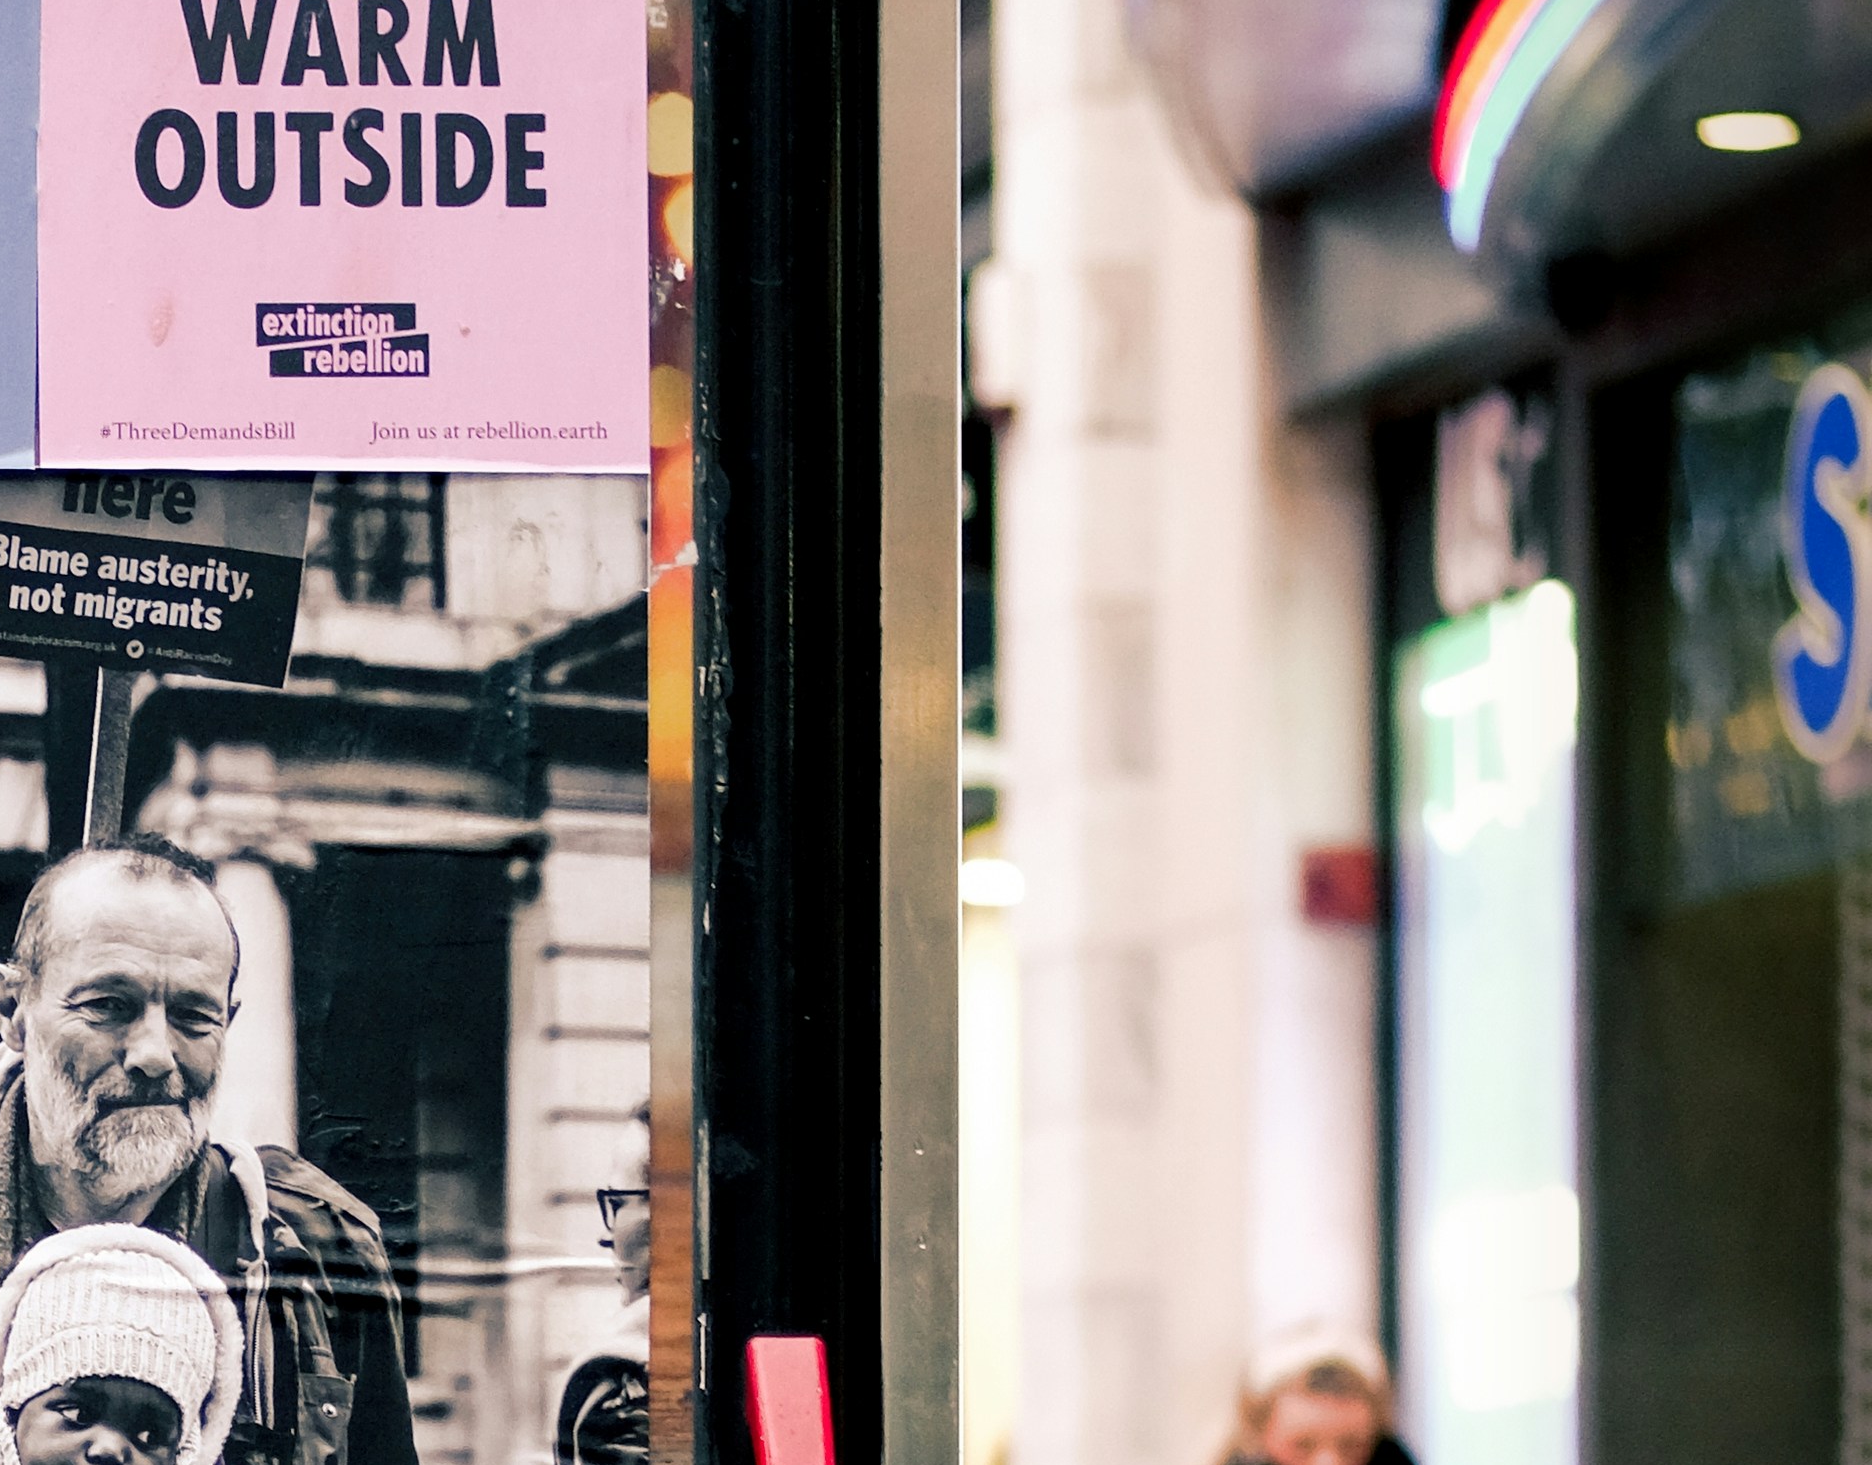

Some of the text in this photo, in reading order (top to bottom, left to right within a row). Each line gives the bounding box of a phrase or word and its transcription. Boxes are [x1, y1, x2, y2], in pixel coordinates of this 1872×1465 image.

[133, 106, 548, 209] OUTSIDE
[262, 306, 395, 338] extinction
[302, 336, 426, 375] rebellion
[99, 420, 296, 442] #ThreeDemandsBill
[369, 420, 609, 445] Join us at rebellion.earth
[97, 554, 254, 604] austerity,
[8, 582, 223, 633] not migrants
